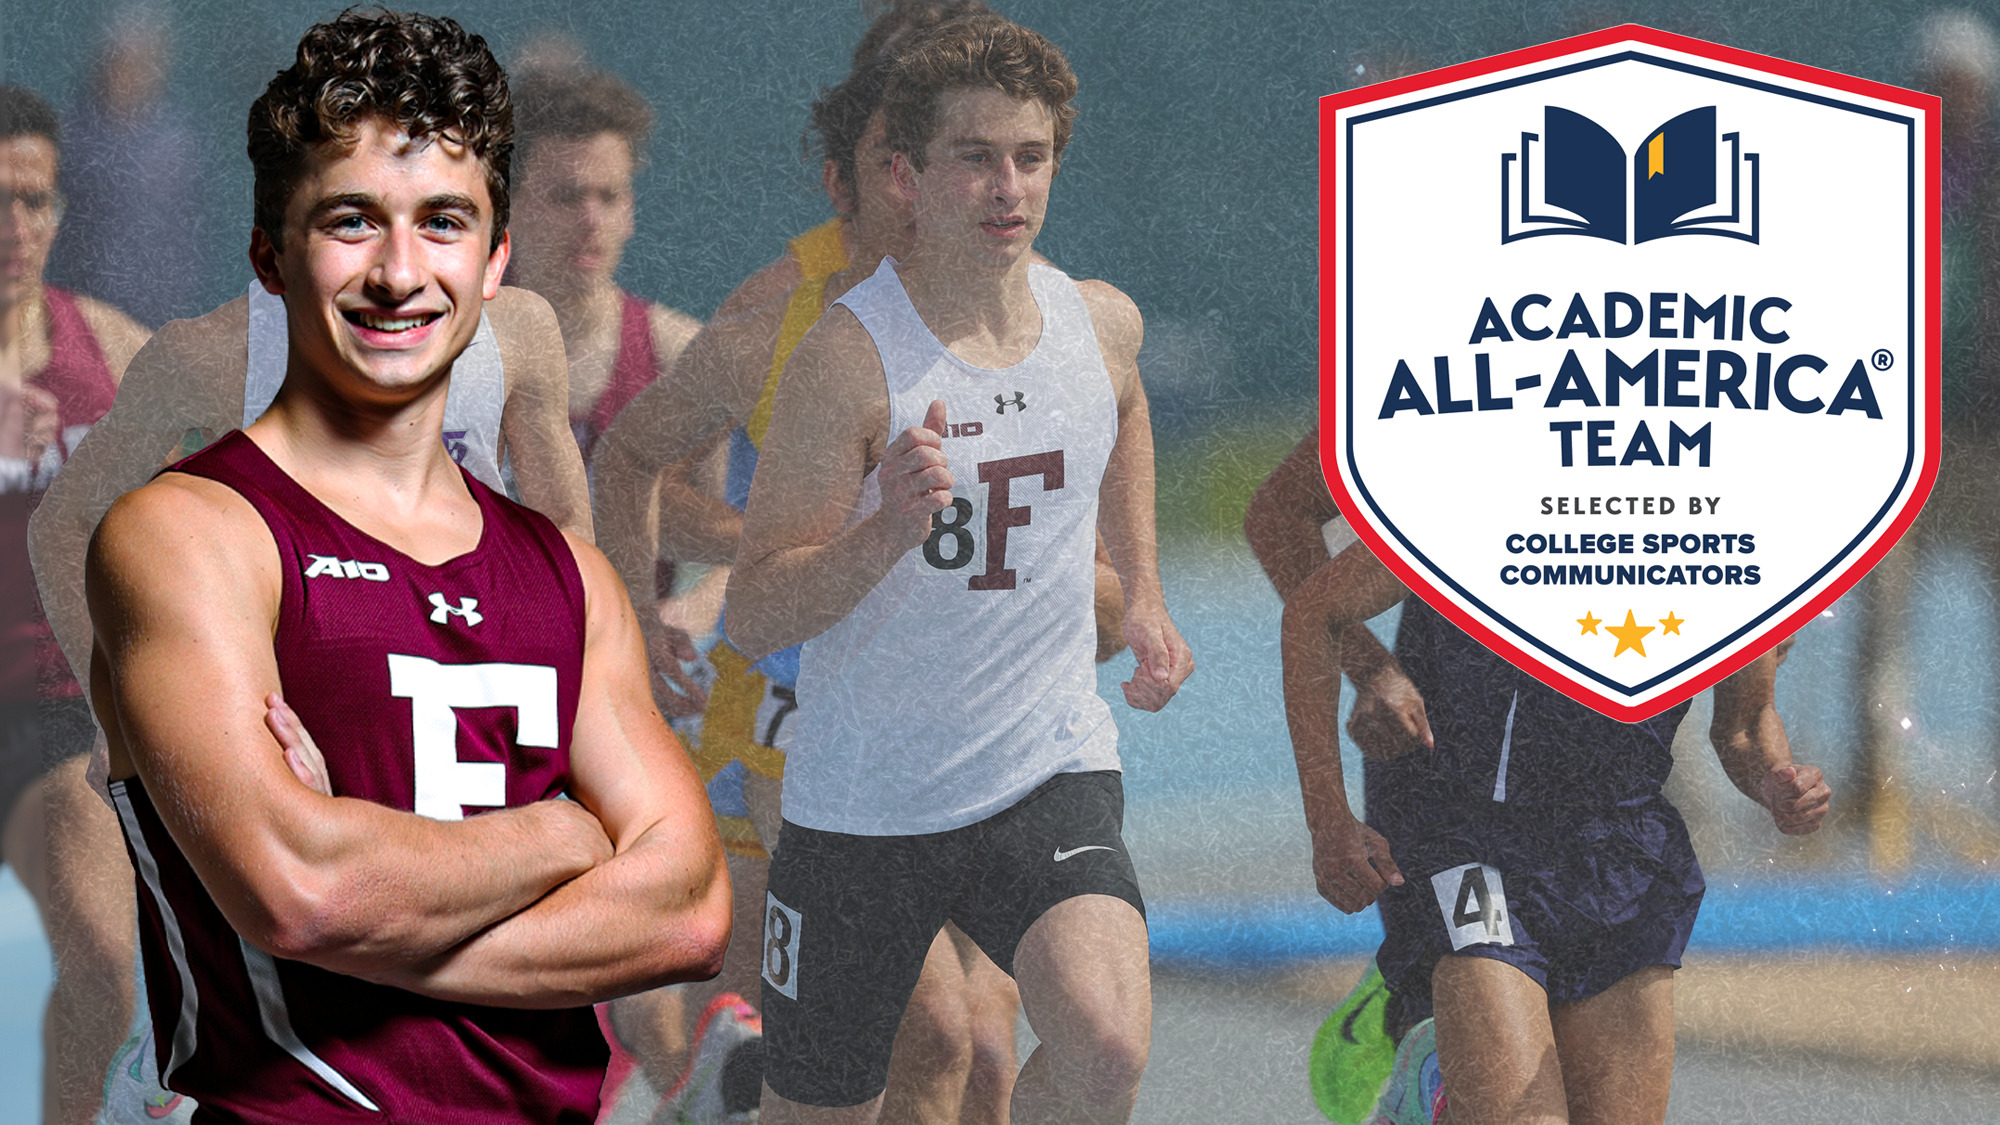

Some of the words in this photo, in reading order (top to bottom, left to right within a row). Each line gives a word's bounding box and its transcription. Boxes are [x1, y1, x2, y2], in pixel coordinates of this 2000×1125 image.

[922, 497, 975, 570] 8
[967, 449, 1065, 591] F
[388, 653, 558, 820] F
[1452, 866, 1503, 936] 4
[767, 905, 792, 987] 8
